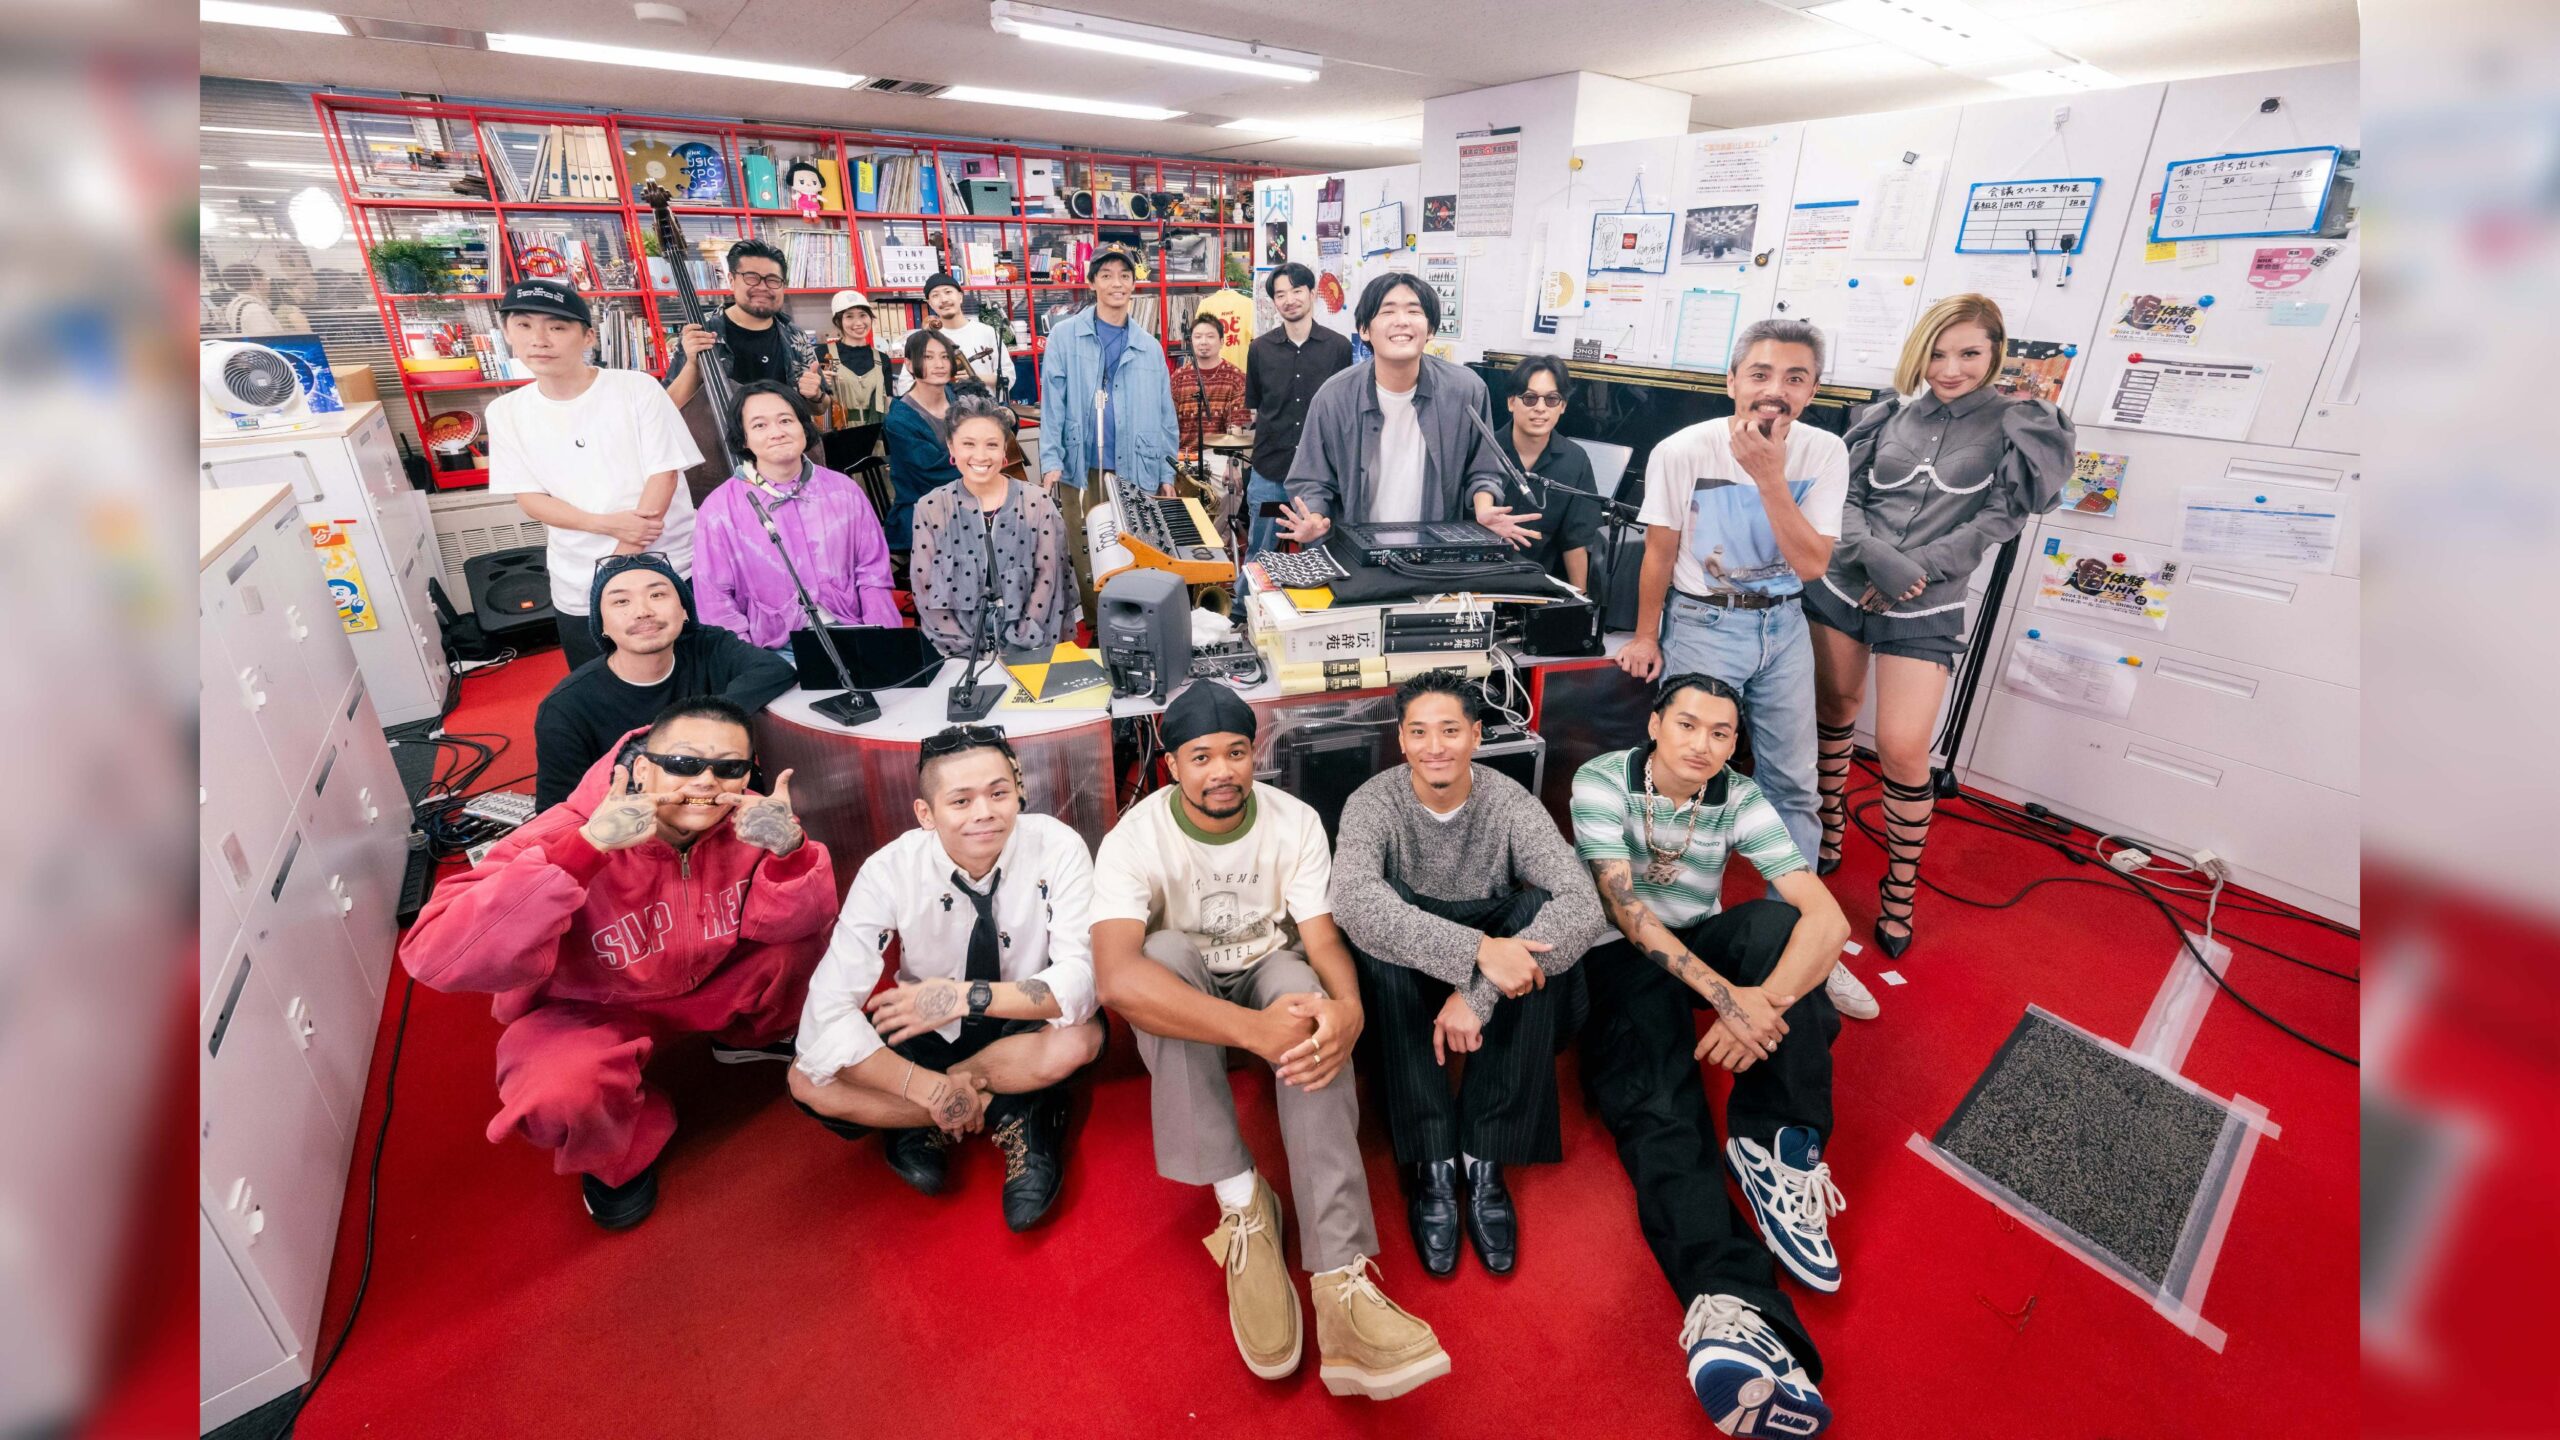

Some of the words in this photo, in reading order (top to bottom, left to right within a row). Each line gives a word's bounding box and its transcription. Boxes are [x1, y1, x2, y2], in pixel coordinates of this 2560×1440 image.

[688, 156, 715, 168] USIC
[688, 168, 717, 179] XPO
[689, 179, 718, 191] 023
[898, 263, 926, 271] DESK
[2156, 317, 2189, 326] NHK
[1096, 520, 1119, 553] moog
[2103, 583, 2139, 596] NHK
[1326, 632, 1371, 651] 広辞苑
[1202, 946, 1254, 966] HOTEL
